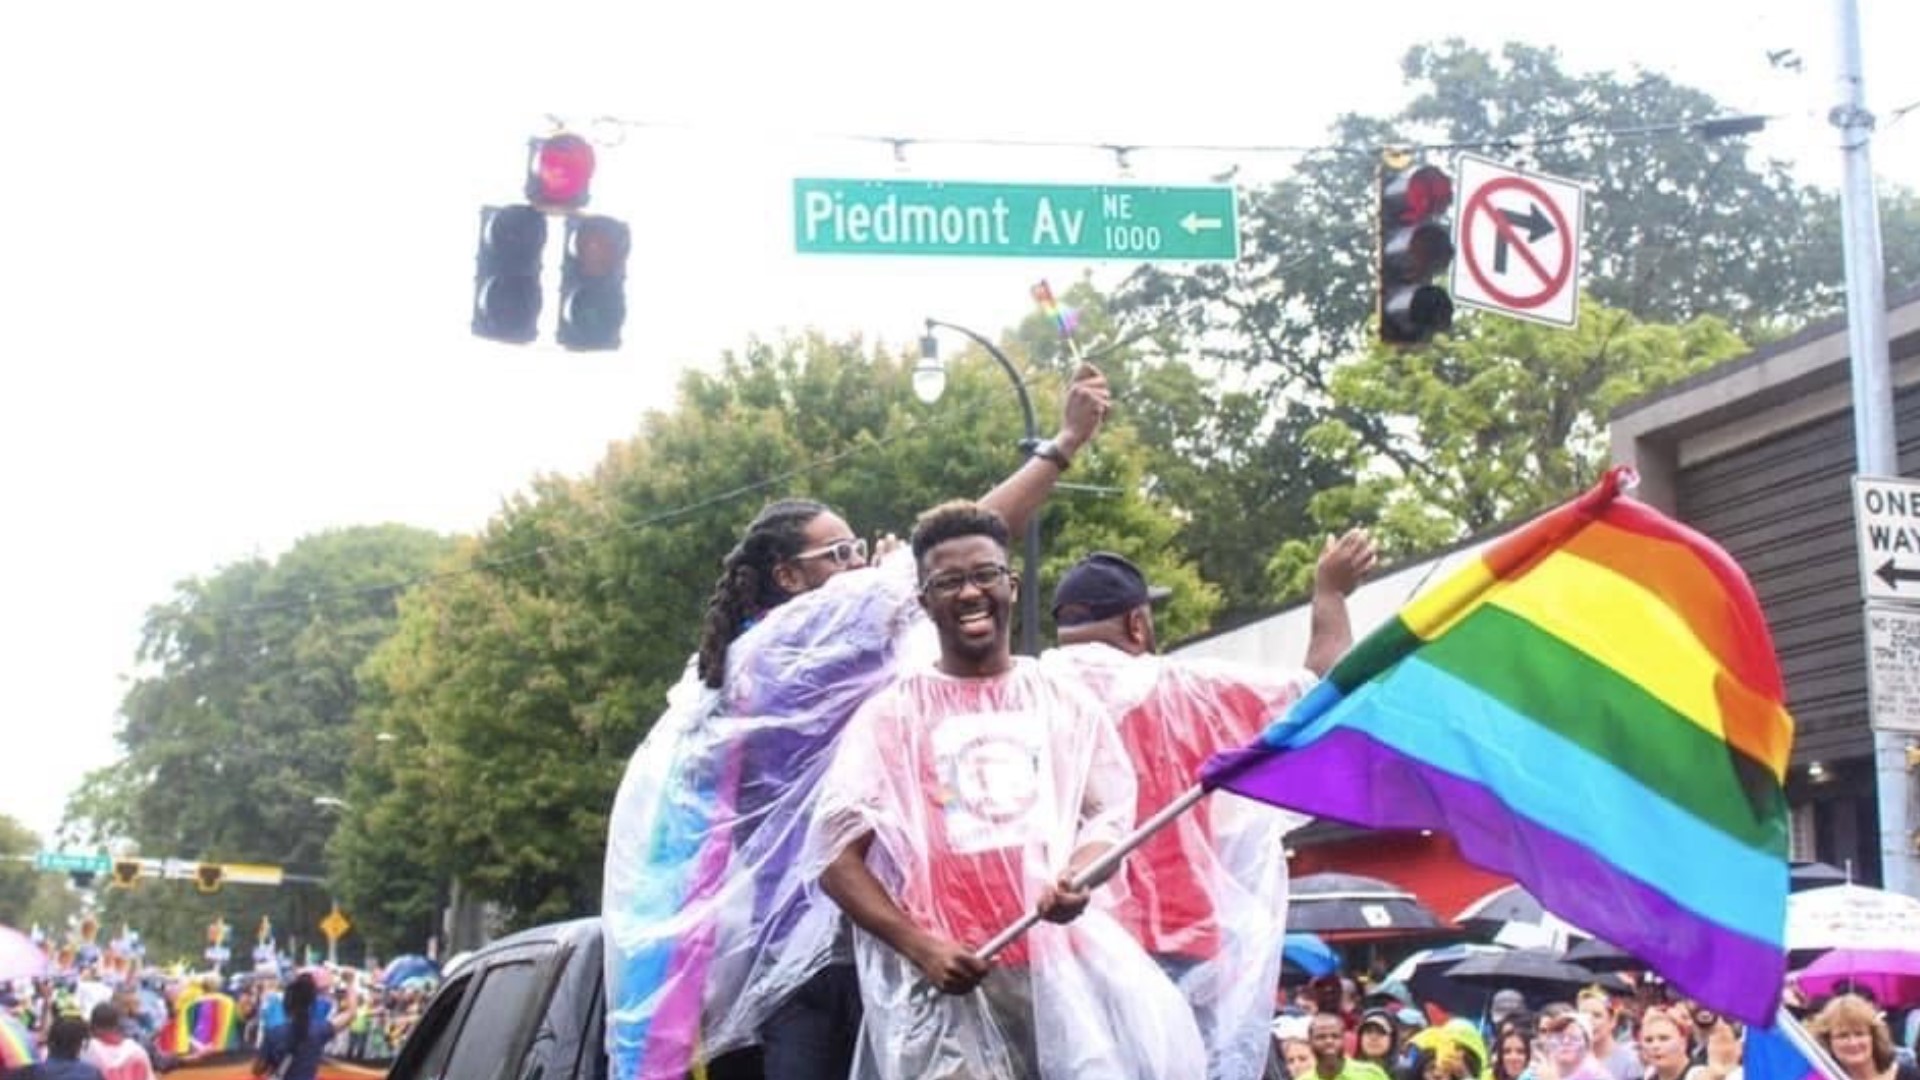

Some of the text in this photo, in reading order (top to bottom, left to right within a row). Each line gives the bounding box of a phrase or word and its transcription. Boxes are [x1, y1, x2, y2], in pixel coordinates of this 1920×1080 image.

[804, 191, 1085, 245] Piedmont Av
[1102, 194, 1133, 219] NE
[1105, 226, 1161, 251] 1000
[1865, 489, 1920, 517] ONE
